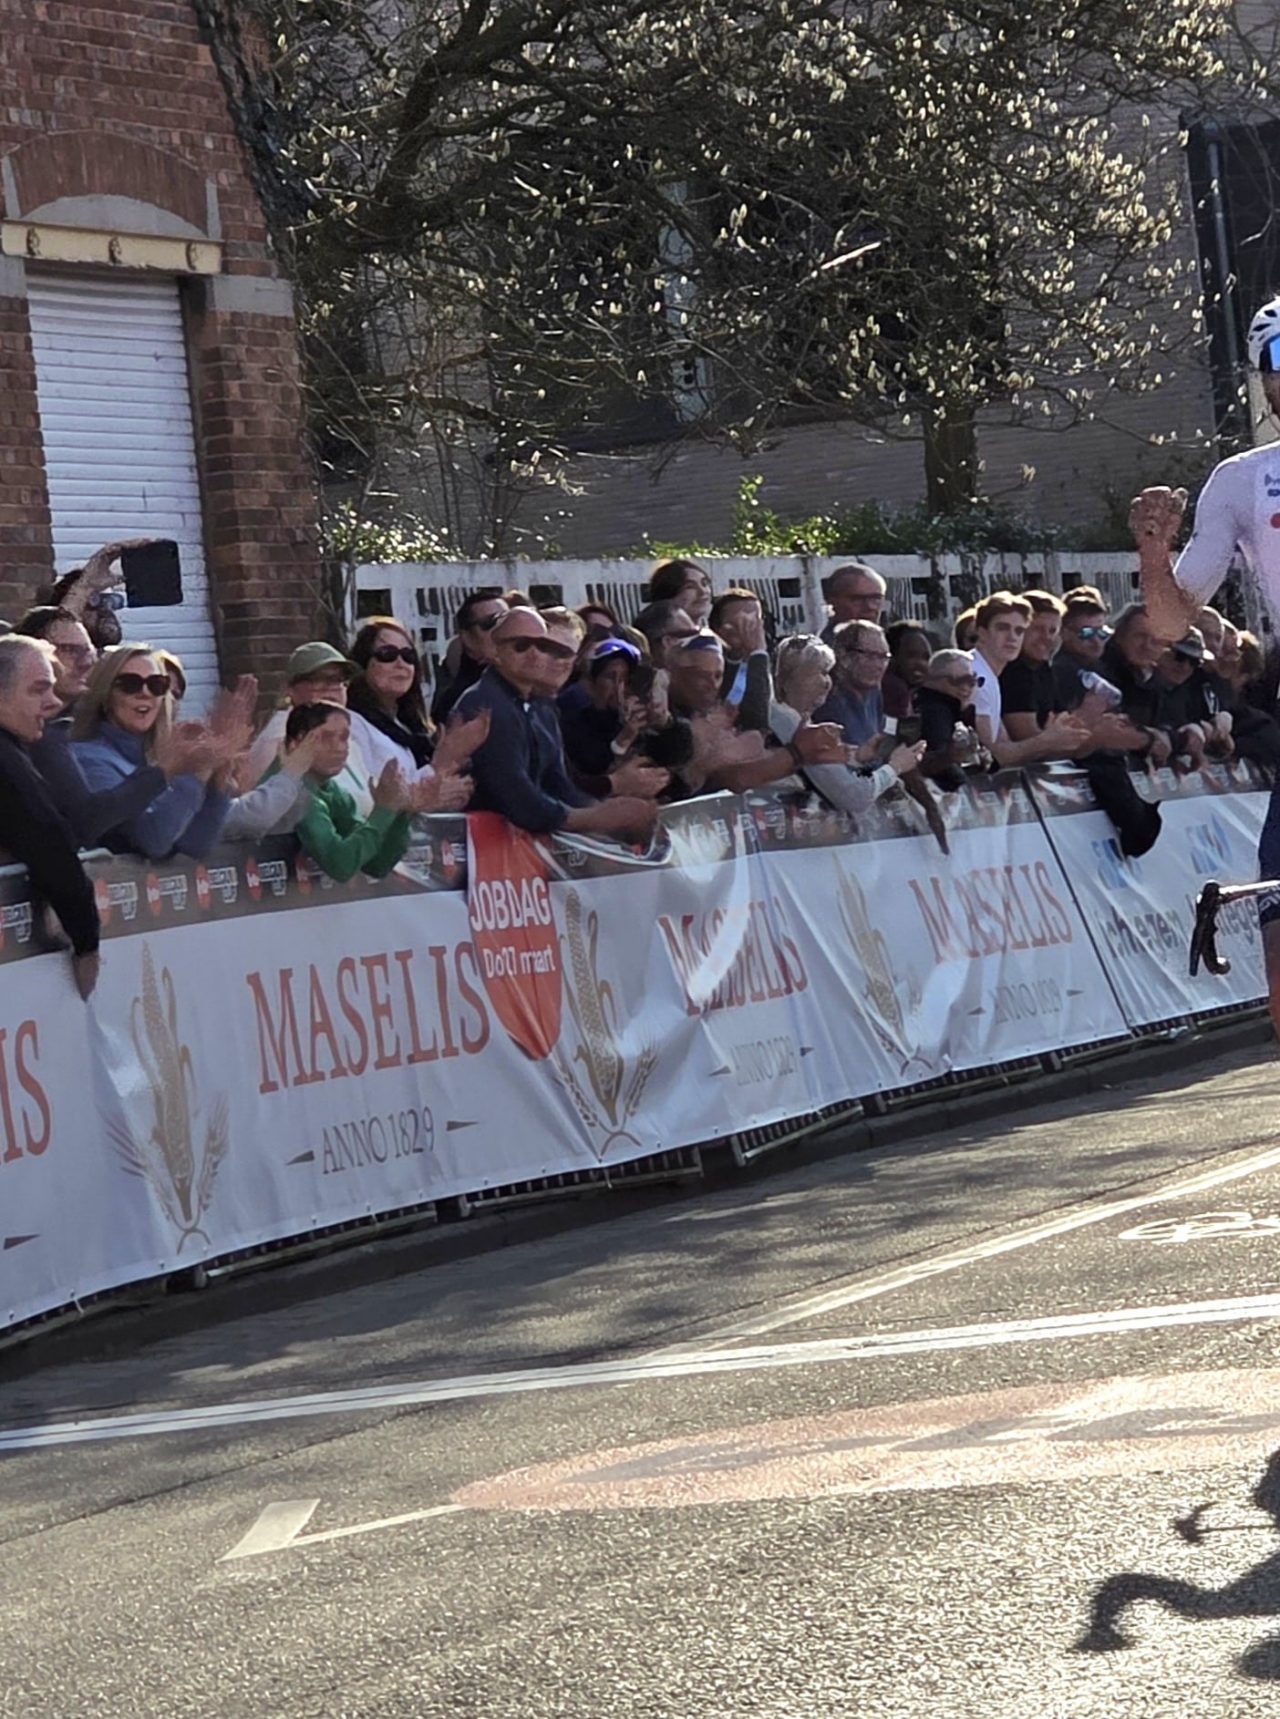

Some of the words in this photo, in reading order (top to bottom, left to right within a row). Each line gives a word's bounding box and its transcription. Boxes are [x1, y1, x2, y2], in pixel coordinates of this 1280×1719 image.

[470, 876, 551, 932] JOBDAG
[907, 860, 1073, 966] MASELIS
[482, 948, 505, 978] Do
[657, 896, 808, 1019] MSELIS
[246, 940, 491, 1096] MASELIS
[322, 1116, 388, 1175] ANNO
[388, 1105, 435, 1159] 1829
